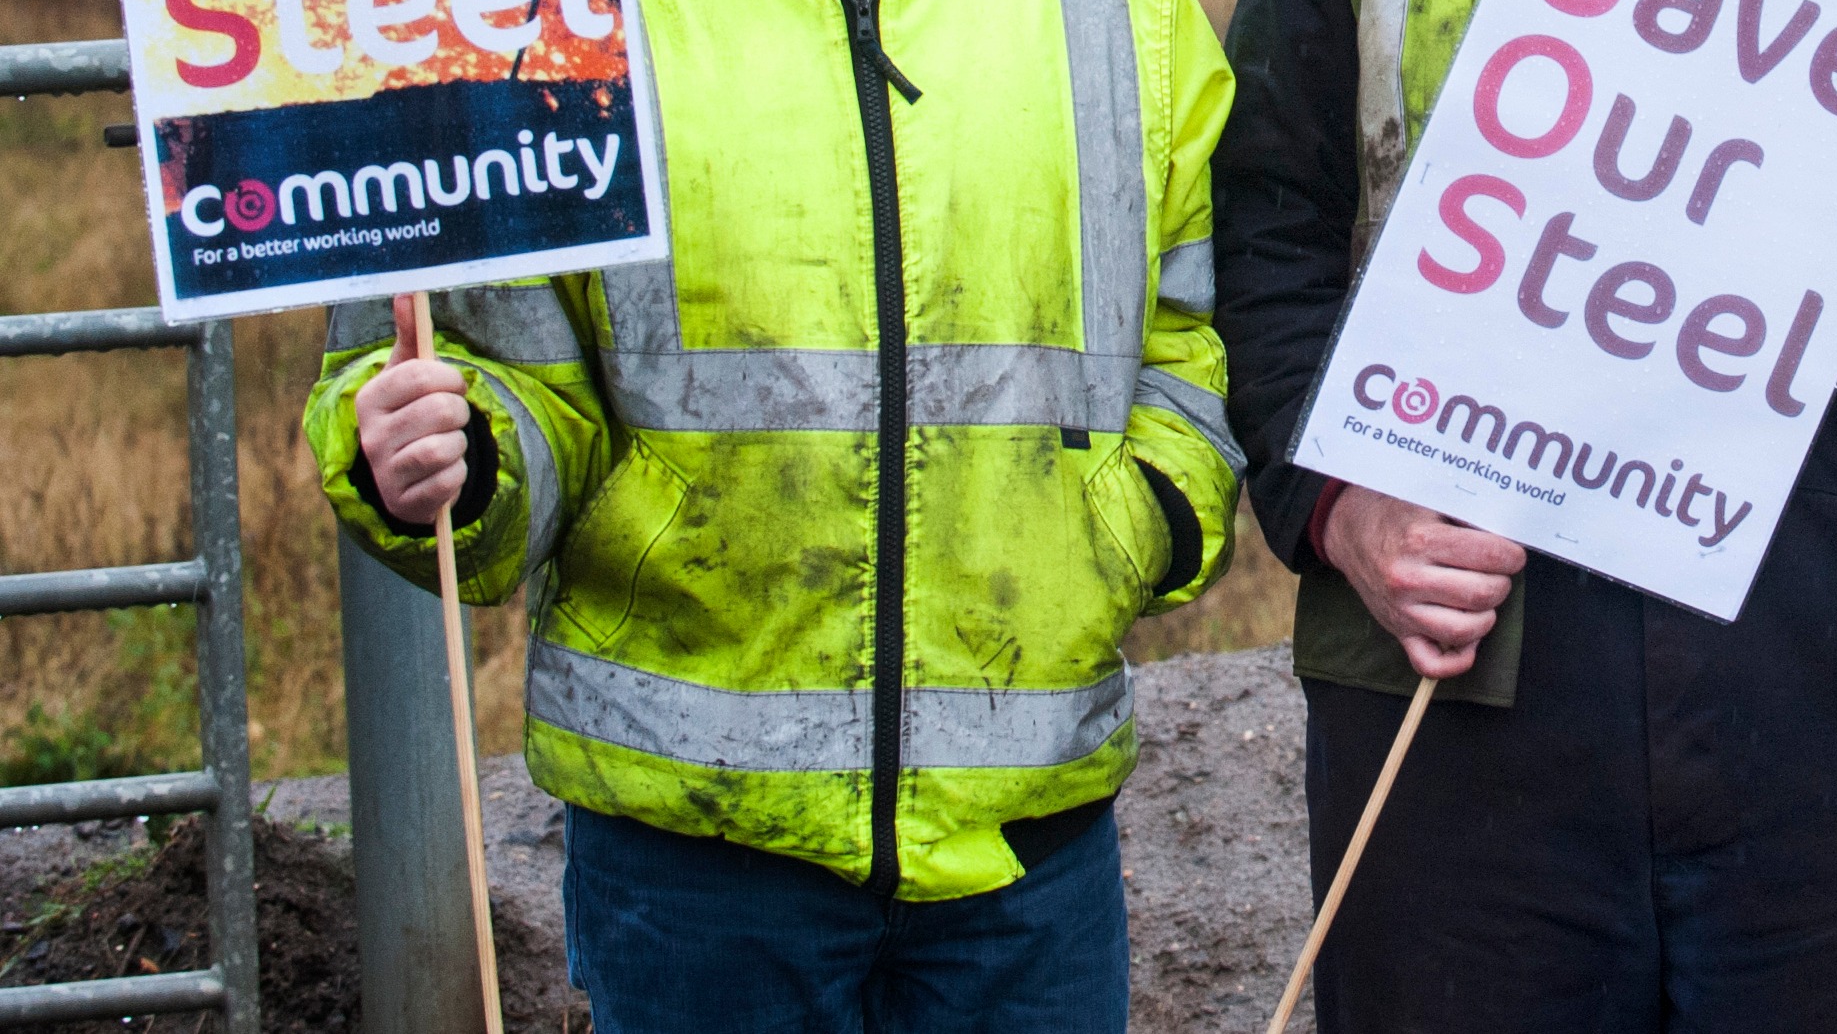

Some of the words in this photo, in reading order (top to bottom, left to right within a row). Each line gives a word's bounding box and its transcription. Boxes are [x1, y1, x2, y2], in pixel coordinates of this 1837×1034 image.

[181, 129, 621, 238] community
[1472, 33, 1764, 226] Our
[193, 245, 224, 266] For
[226, 245, 239, 260] a
[241, 238, 301, 257] better
[303, 228, 383, 249] working
[385, 218, 441, 238] world
[1417, 173, 1825, 418] Steel
[1343, 415, 1372, 436] For
[1371, 427, 1384, 441] a
[1386, 427, 1441, 459] better
[1442, 451, 1512, 490] working
[1515, 479, 1566, 506] world
[1353, 363, 1753, 547] community
